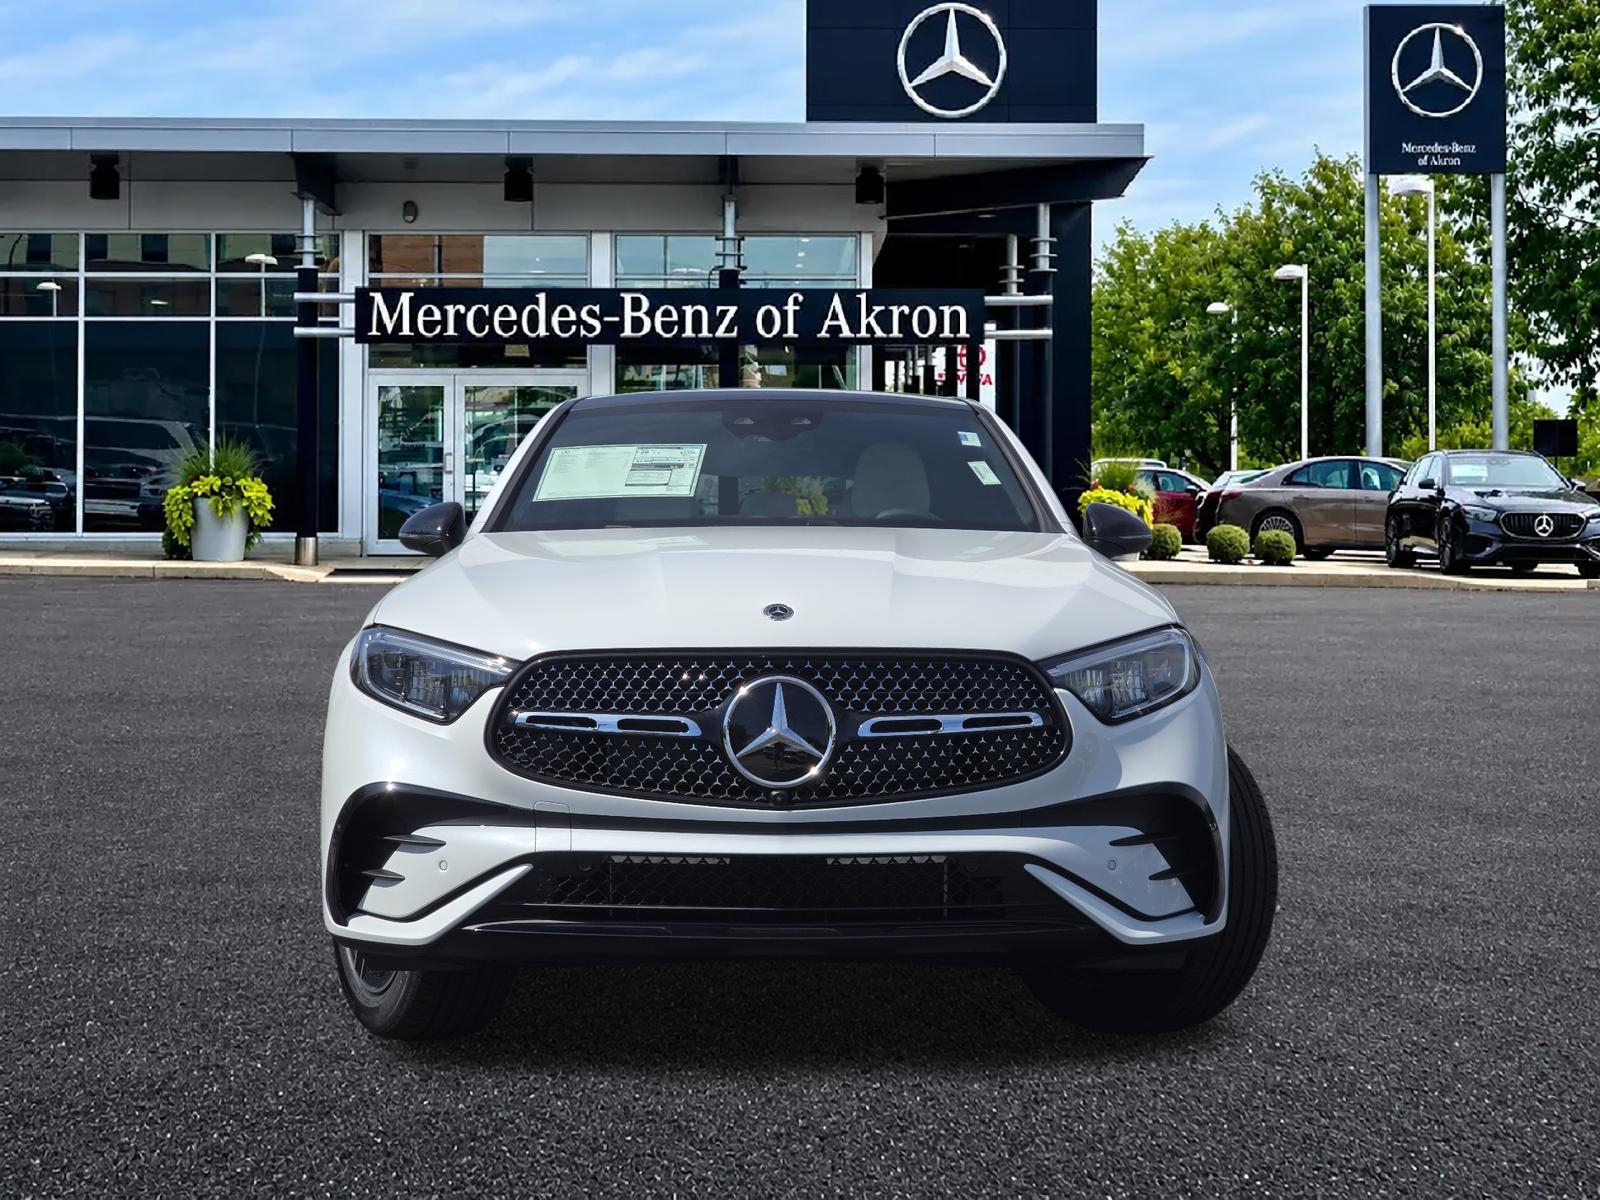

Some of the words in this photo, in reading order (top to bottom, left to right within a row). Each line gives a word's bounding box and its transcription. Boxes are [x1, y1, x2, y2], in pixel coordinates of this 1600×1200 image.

[1401, 141, 1477, 153] Mercedes-Benz
[1417, 154, 1428, 166] of
[1430, 154, 1461, 166] Akron
[367, 291, 738, 338] Mercedes-Benz
[755, 292, 804, 338] of
[817, 292, 971, 338] Akron
